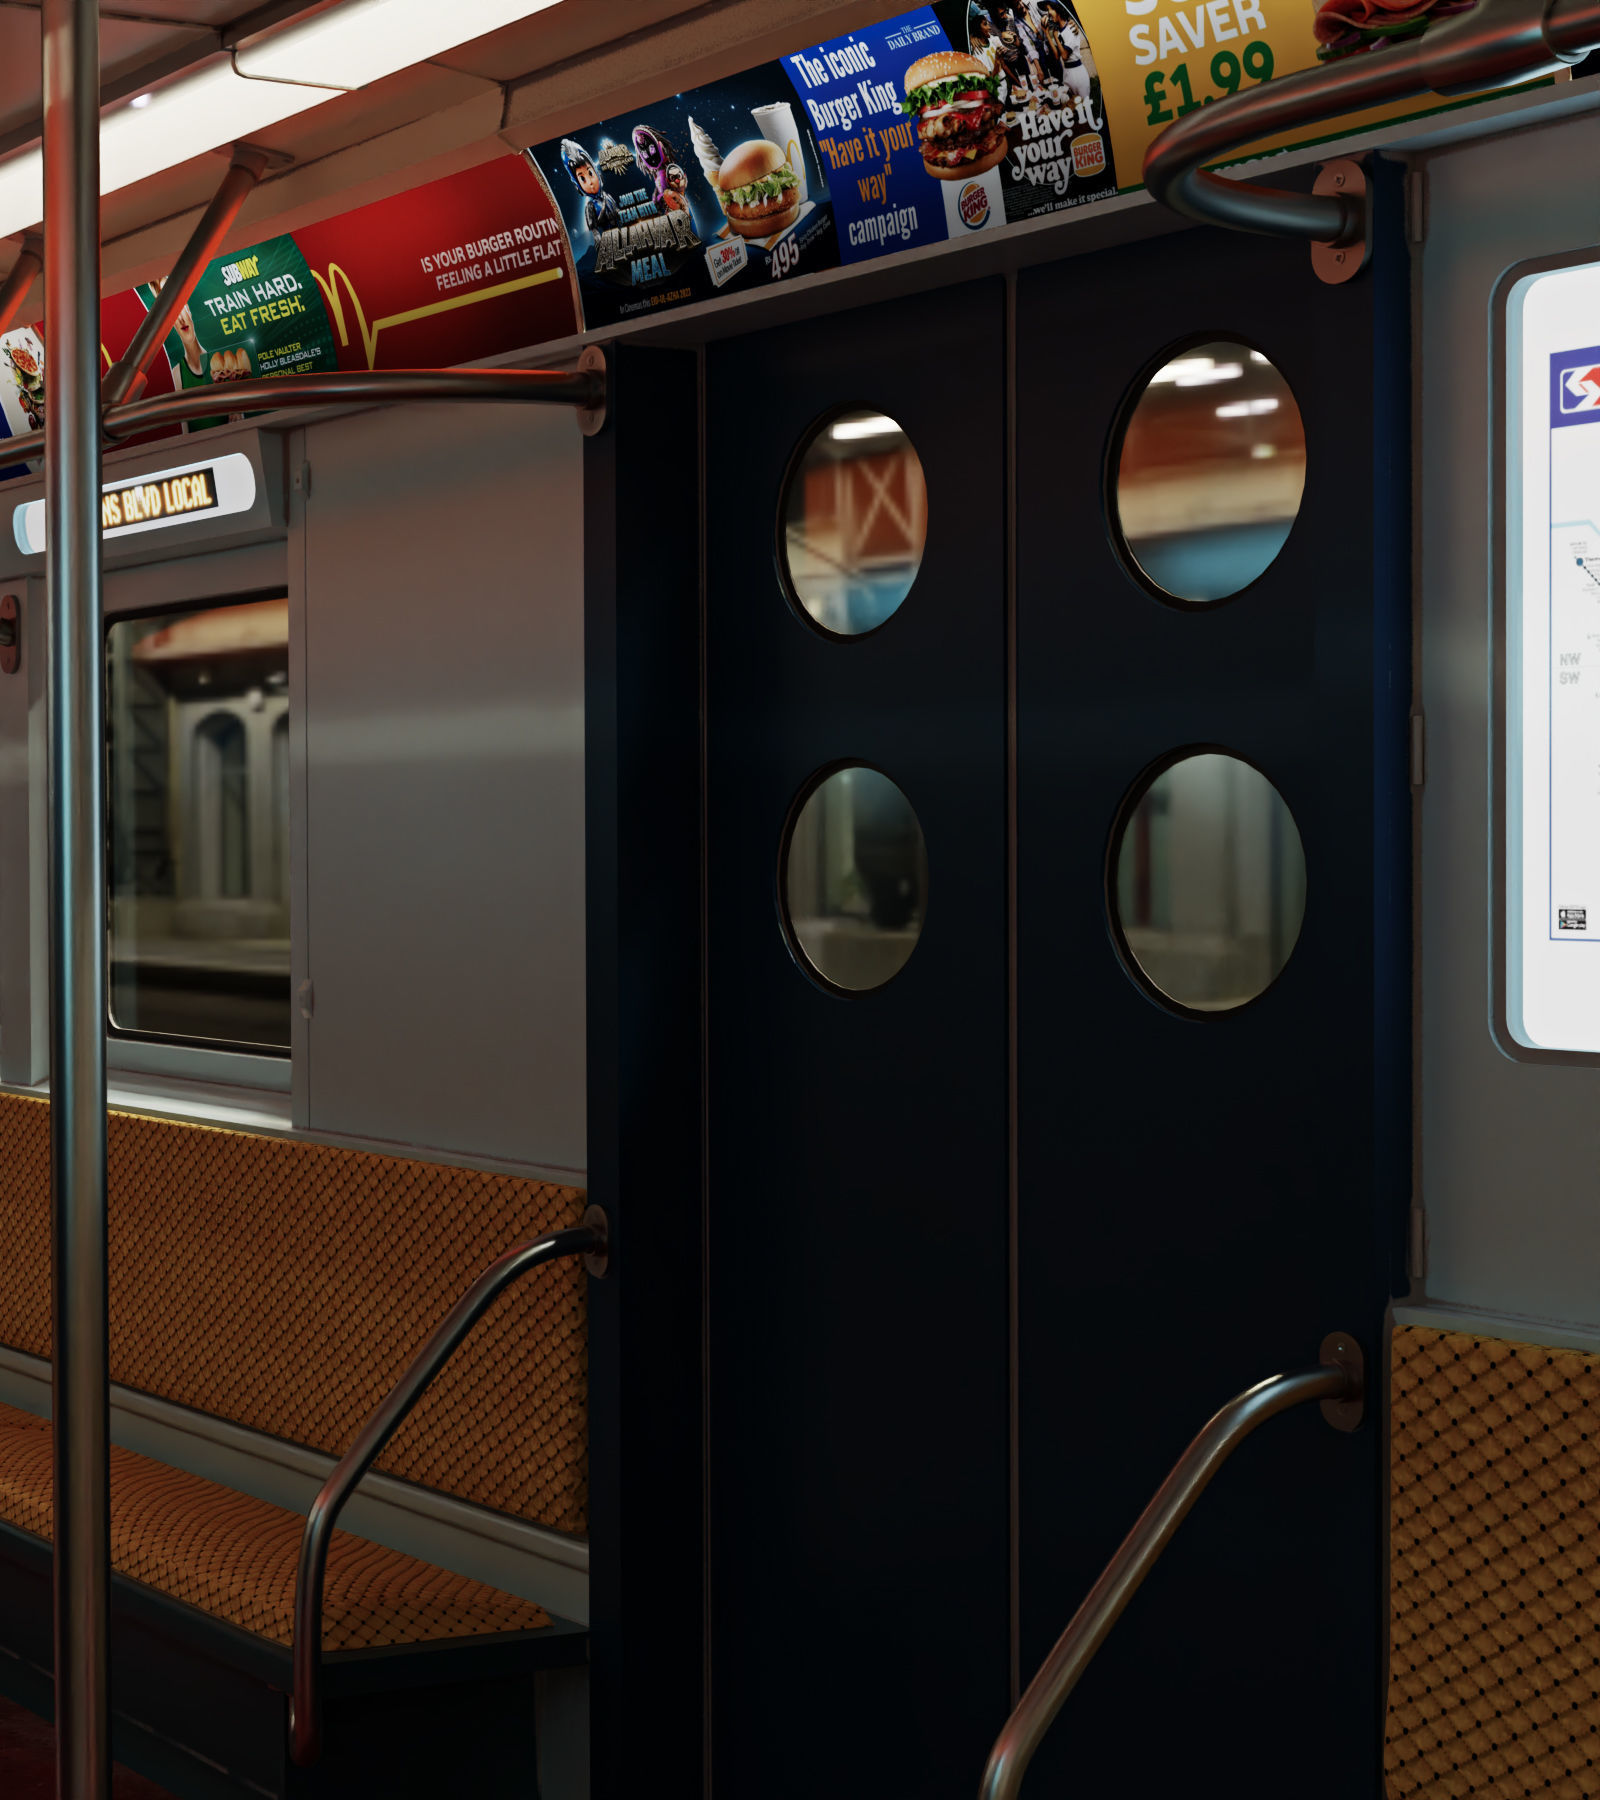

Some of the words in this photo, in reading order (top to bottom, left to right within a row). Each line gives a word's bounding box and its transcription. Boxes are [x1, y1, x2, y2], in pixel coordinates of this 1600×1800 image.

[887, 33, 912, 51] DAILY
[913, 24, 941, 43] BRAND
[900, 25, 913, 35] THE
[1129, 0, 1267, 66] SAVER
[790, 53, 830, 89] The
[818, 36, 877, 80] iconic
[1144, 41, 1275, 126] £1.99
[806, 92, 863, 132] Burger
[857, 79, 903, 116] King
[1020, 107, 1075, 141] Have
[1074, 95, 1104, 131] it
[818, 136, 865, 170] "Have
[862, 127, 881, 159] it
[878, 121, 915, 162] your
[1011, 128, 1073, 182] your
[1073, 141, 1102, 157] BURGER
[1075, 151, 1103, 169] KING
[856, 162, 893, 205] way"
[1025, 157, 1072, 196] way
[618, 205, 639, 224] TEAM
[636, 200, 658, 218] WITH
[619, 191, 634, 208] JOIN
[633, 187, 649, 202] THE
[961, 186, 986, 211] BURGER
[963, 195, 988, 223] KING
[1055, 196, 1078, 211] make
[1079, 194, 1087, 204] it
[1086, 186, 1119, 204] special.
[848, 203, 919, 246] campaign
[420, 256, 434, 274] IS
[432, 246, 466, 270] YOUR
[465, 231, 515, 260] BURGER
[713, 257, 722, 269] Get
[720, 245, 737, 264] 30%
[771, 232, 800, 279] 495
[221, 254, 260, 287] SUBWAY
[435, 263, 483, 291] FEELING
[484, 261, 494, 278] A
[493, 248, 533, 275] LITTLE
[630, 252, 672, 287] MEAL
[204, 287, 253, 317] TRAIN
[251, 273, 303, 303] HARD.
[220, 312, 247, 336] EAT
[257, 351, 274, 362] POLE
[273, 342, 302, 357] VAULTER
[259, 359, 280, 372] HOLLY
[279, 347, 322, 366] BLEASDALE'S
[296, 361, 314, 374] BEST
[123, 484, 163, 521] BLVD
[163, 472, 213, 513] LOCAL
[1560, 652, 1581, 666] NW
[1559, 671, 1580, 685] SW
